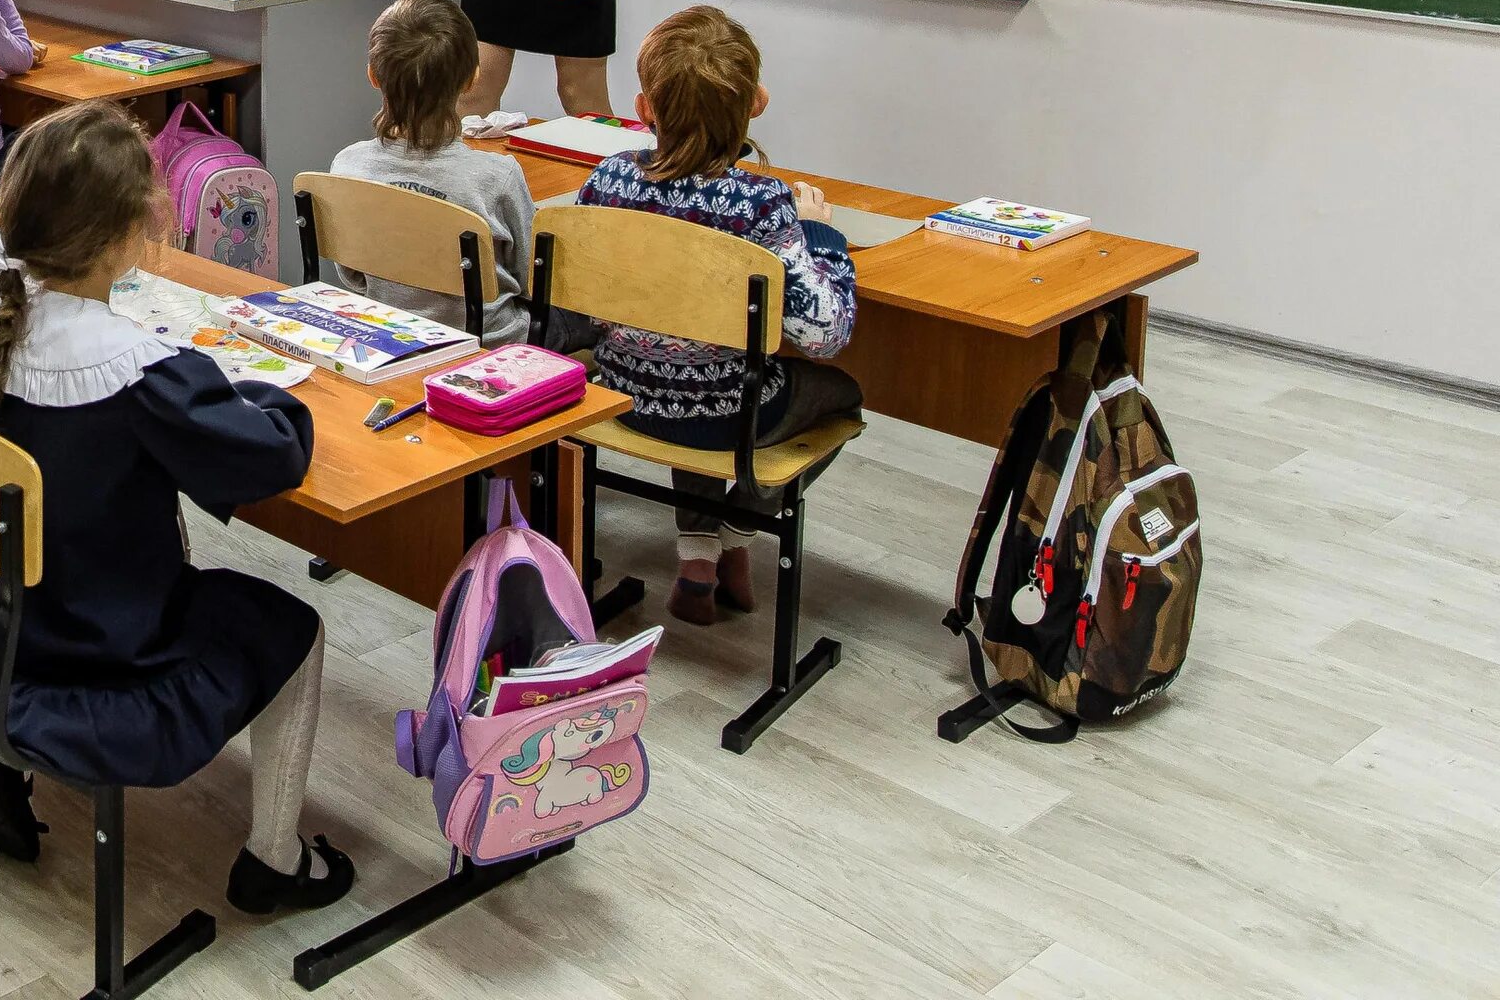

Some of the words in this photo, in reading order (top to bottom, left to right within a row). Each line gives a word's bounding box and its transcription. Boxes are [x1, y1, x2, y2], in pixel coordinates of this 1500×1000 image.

[946, 223, 995, 239] ПЛАСТИЛИН
[997, 234, 1011, 245] 12
[344, 327, 379, 342] CLAY
[262, 334, 311, 361] ПЛАСТИЛИН
